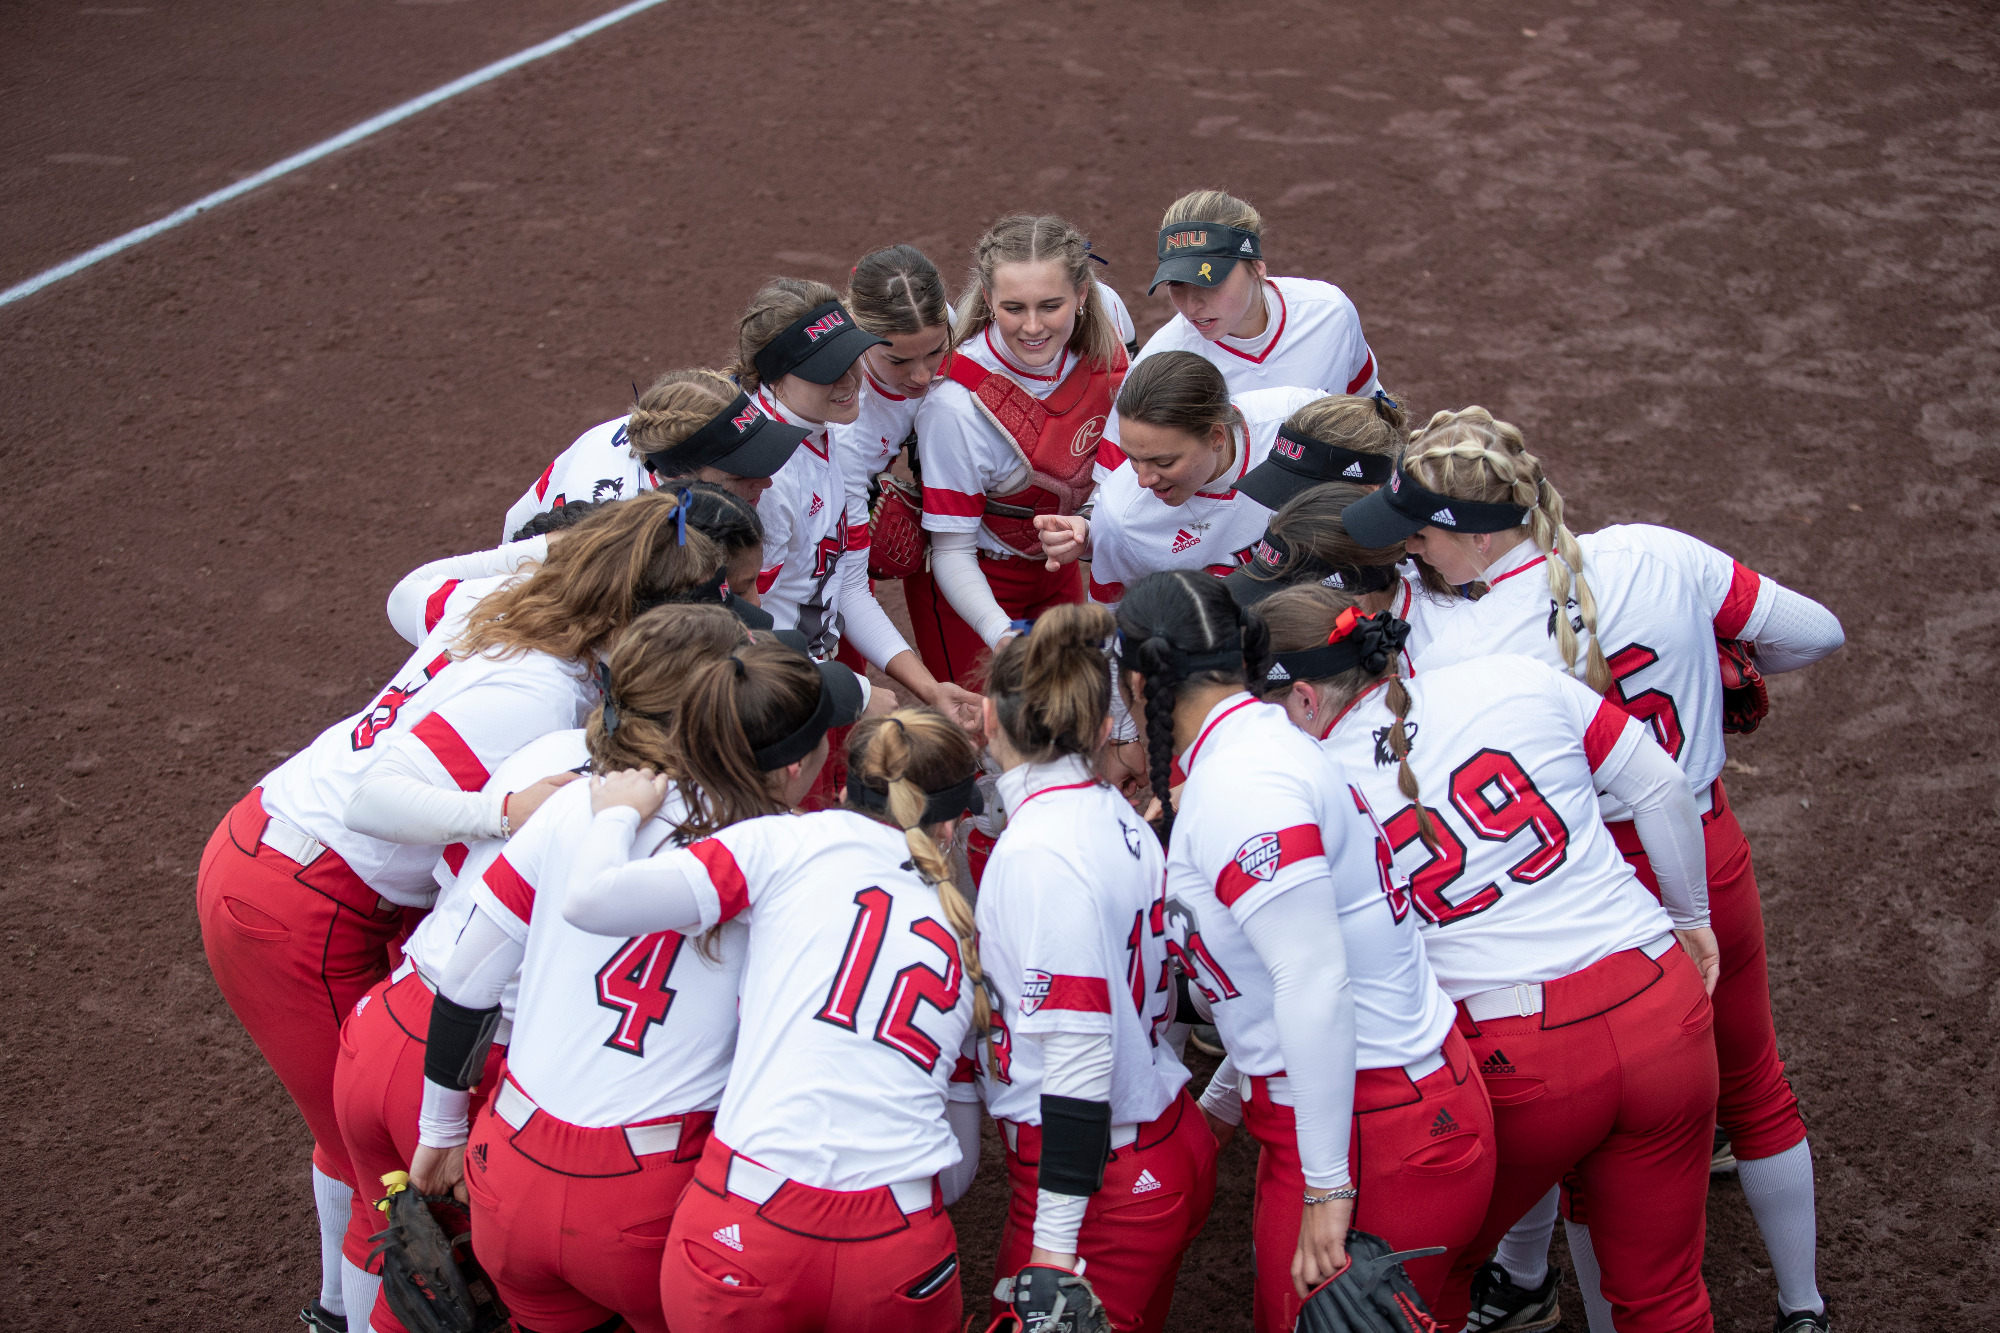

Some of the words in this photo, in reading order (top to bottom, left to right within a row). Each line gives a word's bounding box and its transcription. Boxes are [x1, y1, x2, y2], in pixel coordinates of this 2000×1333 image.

[1166, 230, 1208, 252] NIU
[803, 310, 845, 342] NIU
[1431, 515, 1457, 527] adidas
[1171, 536, 1201, 554] adidas
[1321, 579, 1345, 589] adidas
[1266, 673, 1291, 681] adidas
[1380, 747, 1570, 928] 29
[1240, 841, 1282, 874] MAC
[813, 885, 963, 1076] 12
[1021, 982, 1051, 997] AC
[595, 929, 678, 1059] 4
[1480, 1065, 1516, 1074] adidas
[1132, 1181, 1162, 1194] adidas
[712, 1231, 744, 1252] adidas
